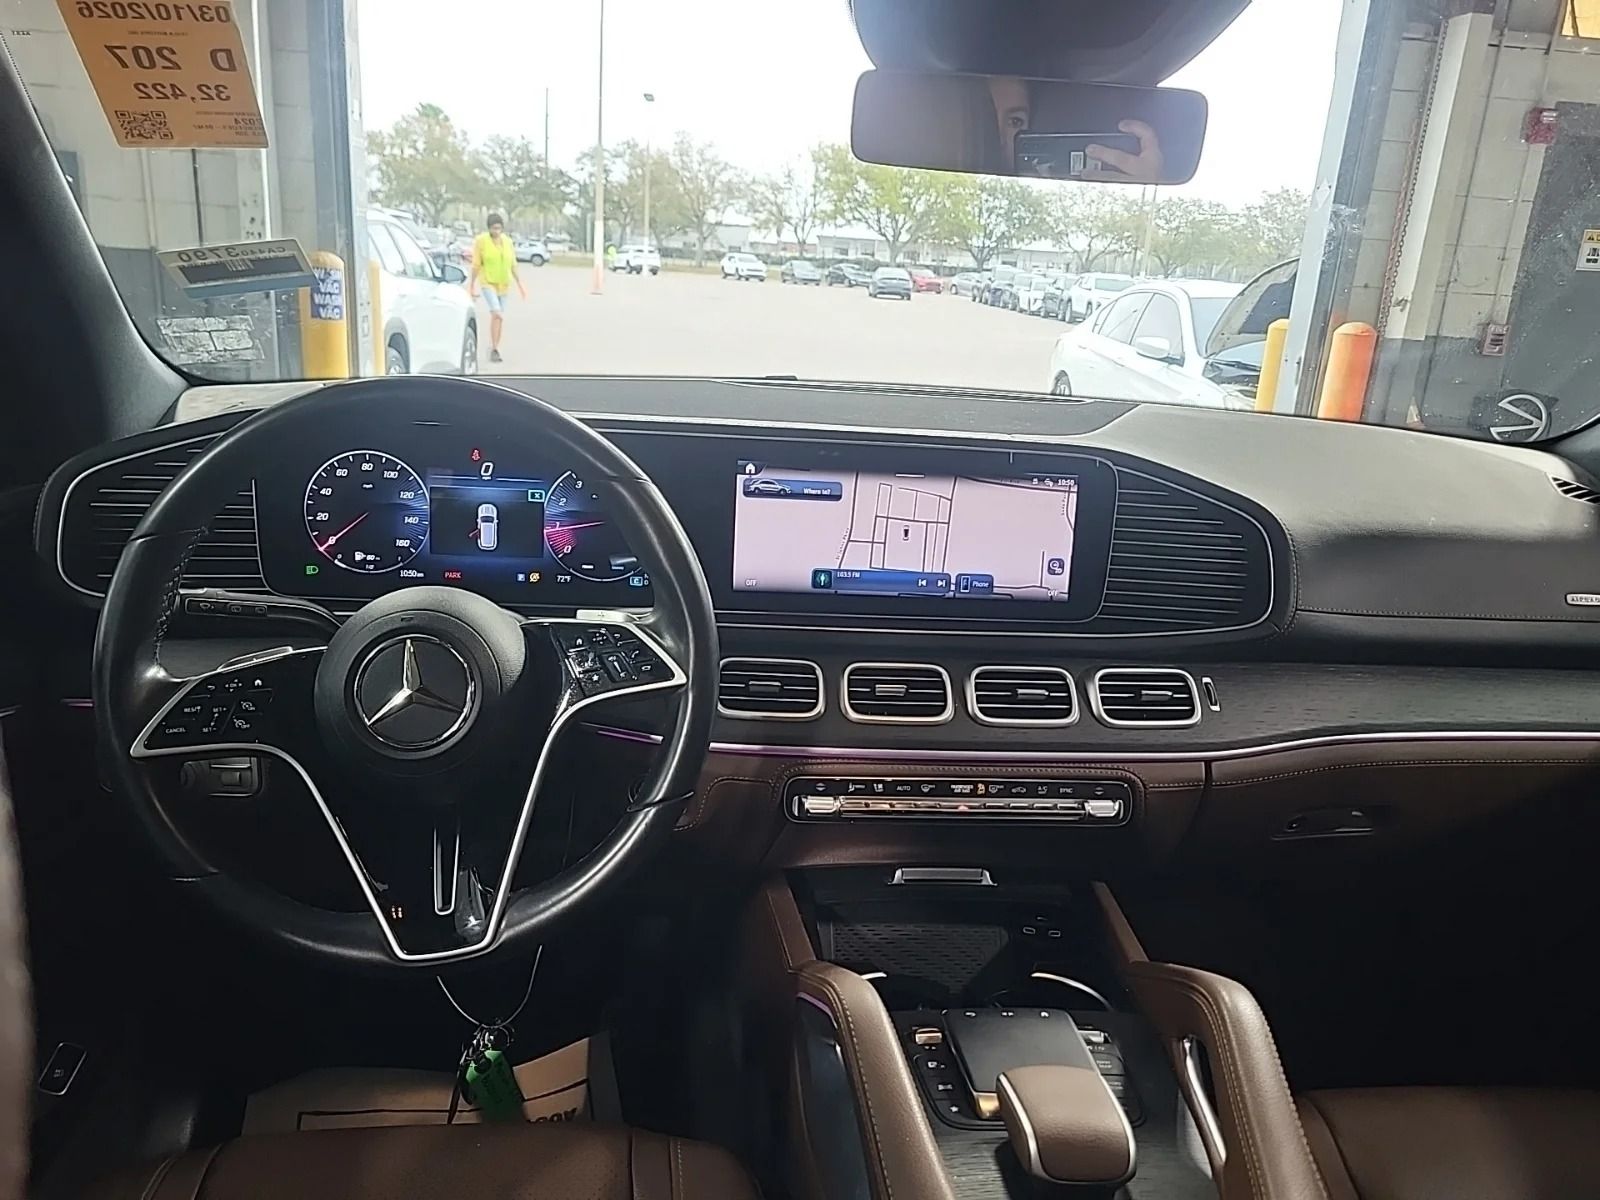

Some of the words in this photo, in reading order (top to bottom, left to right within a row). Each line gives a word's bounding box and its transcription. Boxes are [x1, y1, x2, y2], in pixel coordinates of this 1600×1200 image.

[319, 305, 341, 319] VAC
[361, 463, 373, 471] 80
[481, 462, 494, 476] 0
[335, 468, 348, 477] 60
[383, 470, 398, 478] 100
[575, 480, 582, 489] 3
[400, 491, 414, 499] 120
[803, 487, 821, 495] Where
[316, 512, 329, 520] 20
[404, 516, 419, 524] 140
[395, 539, 410, 547] 160
[444, 571, 462, 579] PARK
[972, 580, 989, 588] Phone
